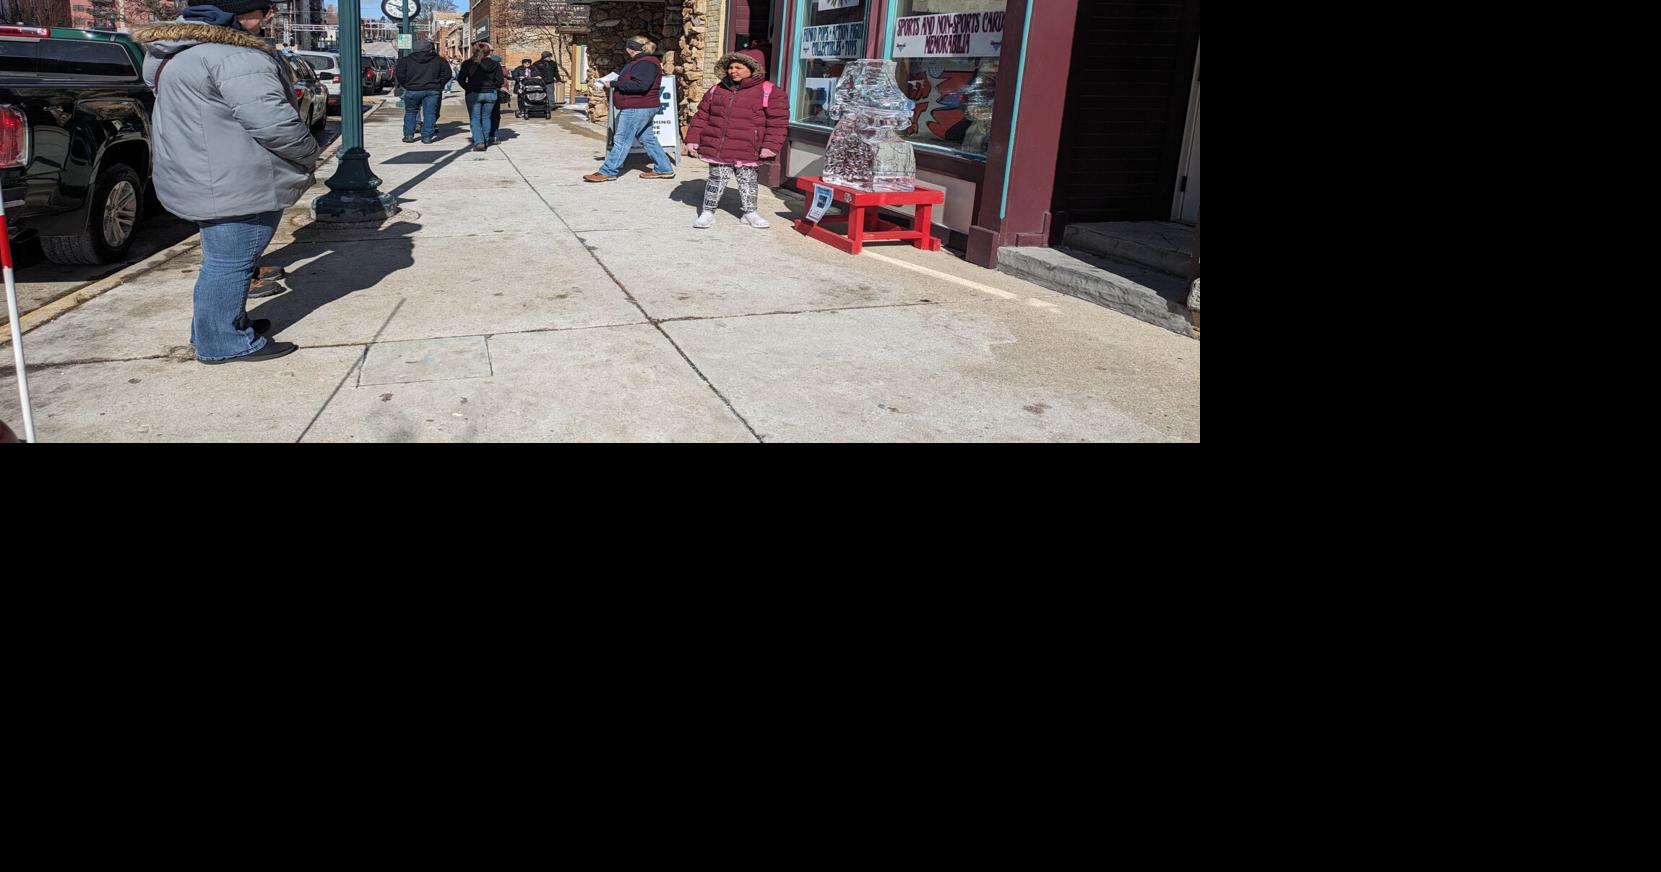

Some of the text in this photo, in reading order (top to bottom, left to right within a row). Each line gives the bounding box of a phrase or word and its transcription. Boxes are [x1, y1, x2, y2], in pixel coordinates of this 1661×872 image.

[897, 18, 921, 37] SPORTS
[920, 16, 936, 35] AND
[936, 11, 982, 34] NON-SPORTS
[923, 33, 971, 54] MEMORABILIA
